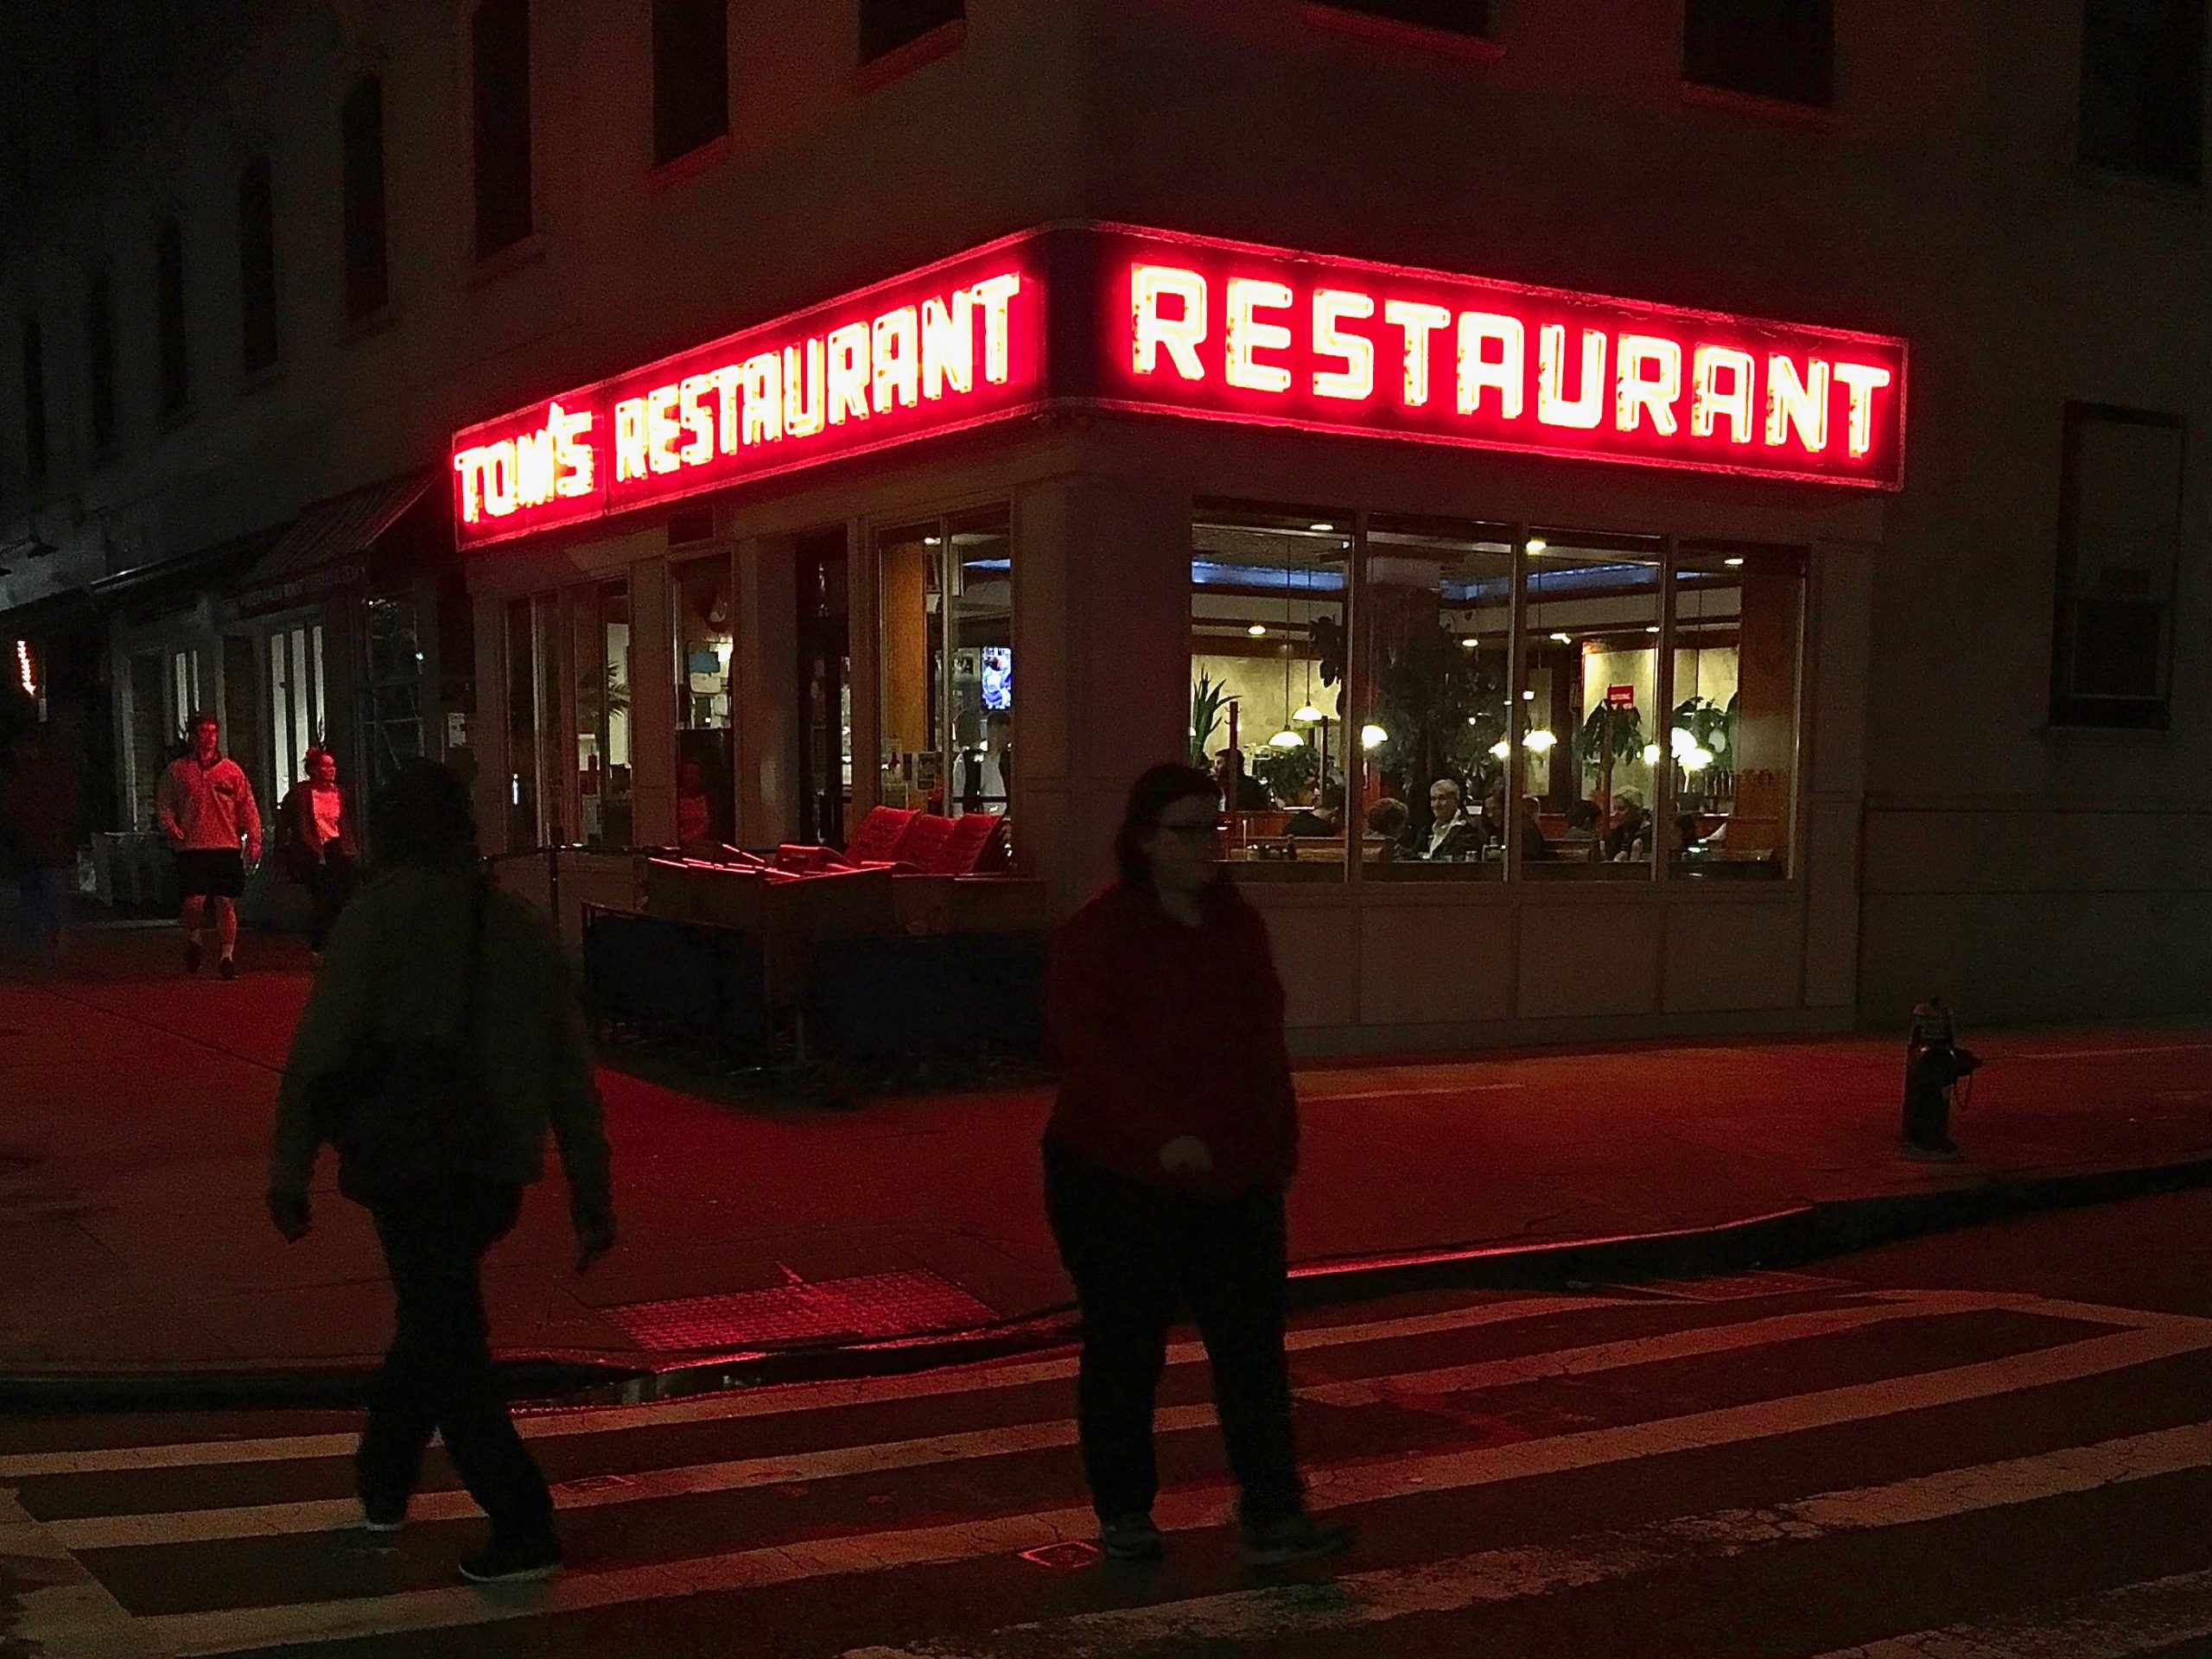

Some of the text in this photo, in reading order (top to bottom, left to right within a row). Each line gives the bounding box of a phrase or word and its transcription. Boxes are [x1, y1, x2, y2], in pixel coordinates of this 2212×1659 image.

[454, 272, 1020, 524] TOM'S RESTAURANT
[1131, 264, 1890, 457] RESTAURANT
